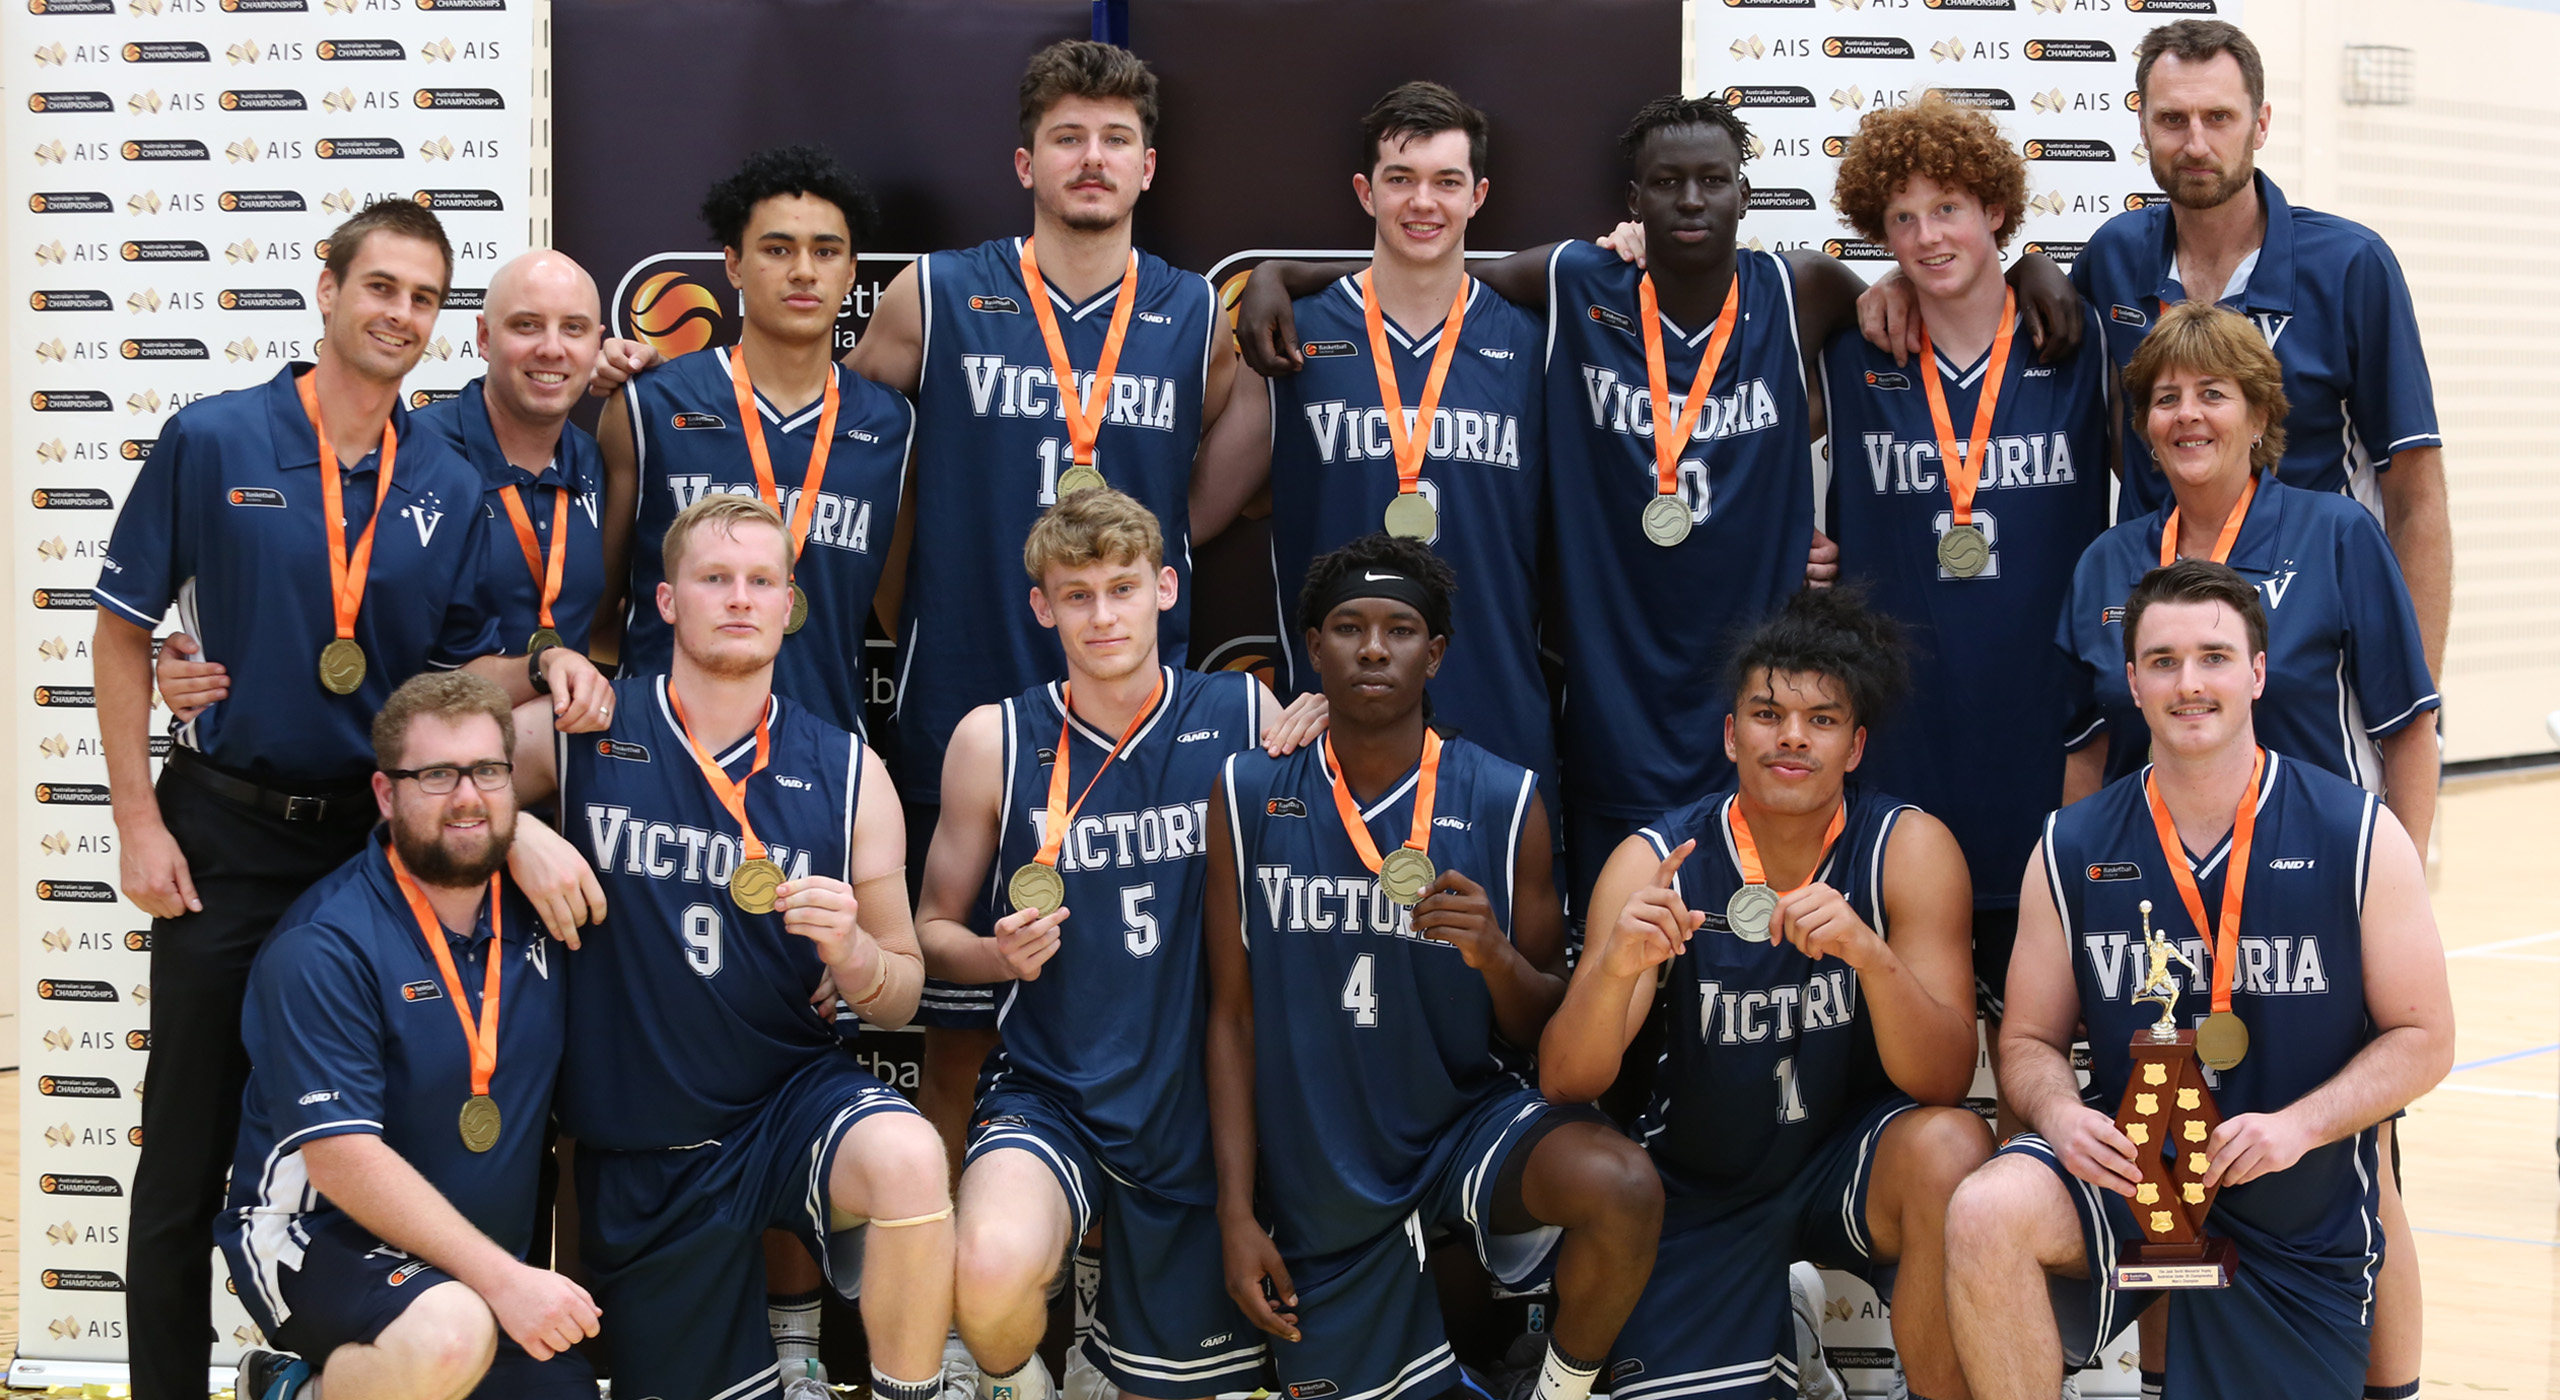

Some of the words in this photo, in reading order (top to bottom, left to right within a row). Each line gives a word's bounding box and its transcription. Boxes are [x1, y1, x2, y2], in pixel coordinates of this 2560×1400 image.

[49, 3, 110, 12] CHAMPIONSHIPS
[171, 0, 205, 12] AIS
[241, 1, 303, 10] CHAMPIONSHIPS
[365, 0, 401, 10] AIS
[437, 0, 500, 8] CHAMPIONSHIPS
[2074, 0, 2111, 11] AIS
[2147, 1, 2211, 10] CHAMPIONSHIPS
[75, 45, 109, 62] AIS
[143, 50, 205, 59] CHAMPIONSHIPS
[268, 43, 302, 60] AIS
[338, 47, 400, 56] CHAMPIONSHIPS
[464, 42, 499, 59] AIS
[1773, 39, 1809, 57] AIS
[1844, 45, 1908, 54] CHAMPIONSHIPS
[1973, 41, 2009, 59] AIS
[2046, 48, 2110, 57] CHAMPIONSHIPS
[47, 99, 109, 109] CHAMPIONSHIPS
[170, 93, 204, 110] AIS
[240, 98, 302, 107] CHAMPIONSHIPS
[364, 91, 399, 109] AIS
[435, 97, 499, 105] CHAMPIONSHIPS
[1745, 94, 1809, 103] CHAMPIONSHIPS
[1873, 90, 1908, 107] AIS
[2074, 93, 2110, 111] AIS
[74, 143, 108, 160] AIS
[142, 148, 204, 157] CHAMPIONSHIPS
[267, 141, 301, 159] AIS
[336, 146, 399, 155] CHAMPIONSHIPS
[462, 140, 498, 158] AIS
[1773, 139, 1809, 156] AIS
[2045, 148, 2110, 157] CHAMPIONSHIPS
[47, 200, 109, 209] CHAMPIONSHIPS
[169, 194, 204, 211] AIS
[239, 198, 301, 208] CHAMPIONSHIPS
[434, 198, 497, 206] CHAMPIONSHIPS
[2073, 195, 2109, 213] AIS
[74, 244, 108, 261] AIS
[142, 248, 204, 258] CHAMPIONSHIPS
[266, 242, 301, 260] AIS
[462, 242, 497, 259] AIS
[48, 298, 108, 307] CHAMPIONSHIPS
[169, 292, 204, 309] AIS
[239, 297, 301, 306] CHAMPIONSHIPS
[1140, 312, 1163, 324] AND
[2255, 313, 2293, 350] V
[74, 342, 108, 359] AIS
[141, 347, 204, 355] CHAMPIONSHIPS
[266, 341, 301, 358] AIS
[1480, 349, 1508, 359] AND
[1508, 352, 1515, 360] 1
[2023, 368, 2051, 377] AND
[49, 399, 108, 407] CHAMPIONSHIPS
[849, 430, 872, 442] AND
[873, 436, 879, 444] 1
[74, 442, 108, 460] AIS
[49, 497, 108, 505] CHAMPIONSHIPS
[581, 493, 598, 529] V
[667, 474, 872, 554] VRIA
[409, 504, 444, 547] V
[75, 540, 108, 557] AIS
[1932, 509, 2000, 581] 12
[2261, 572, 2297, 609] V
[1178, 731, 1210, 743] AND
[1212, 730, 1219, 739] 1
[776, 775, 803, 789] AND
[52, 793, 110, 802] CHAMPIONSHIPS
[1434, 818, 1465, 830] AND
[77, 835, 111, 853] AIS
[586, 803, 813, 889] VICTOIA
[2270, 859, 2304, 869] AND
[2307, 860, 2315, 869] 1
[53, 889, 112, 898] CHAMPIONSHIPS
[1256, 864, 1460, 948] VICTO
[1119, 882, 1161, 958] 5
[79, 933, 112, 950] AIS
[681, 902, 723, 979] 9
[2083, 931, 2329, 1001] VITRIA
[54, 988, 113, 998] CHAMPIONSHIPS
[1341, 953, 1378, 1028] 4
[80, 1032, 115, 1049] AIS
[56, 1084, 115, 1094] CHAMPIONSHIPS
[1773, 1055, 1808, 1125] 1
[299, 1091, 331, 1105] AND
[332, 1091, 340, 1100] 1
[82, 1128, 116, 1145] AIS
[58, 1182, 117, 1192] CHAMPIONSHIPS
[85, 1226, 119, 1243] AIS
[61, 1278, 120, 1287] CHAMPIONSHIPS
[88, 1321, 122, 1338] AIS
[1202, 1335, 1226, 1347] AND
[1227, 1333, 1233, 1341] 1
